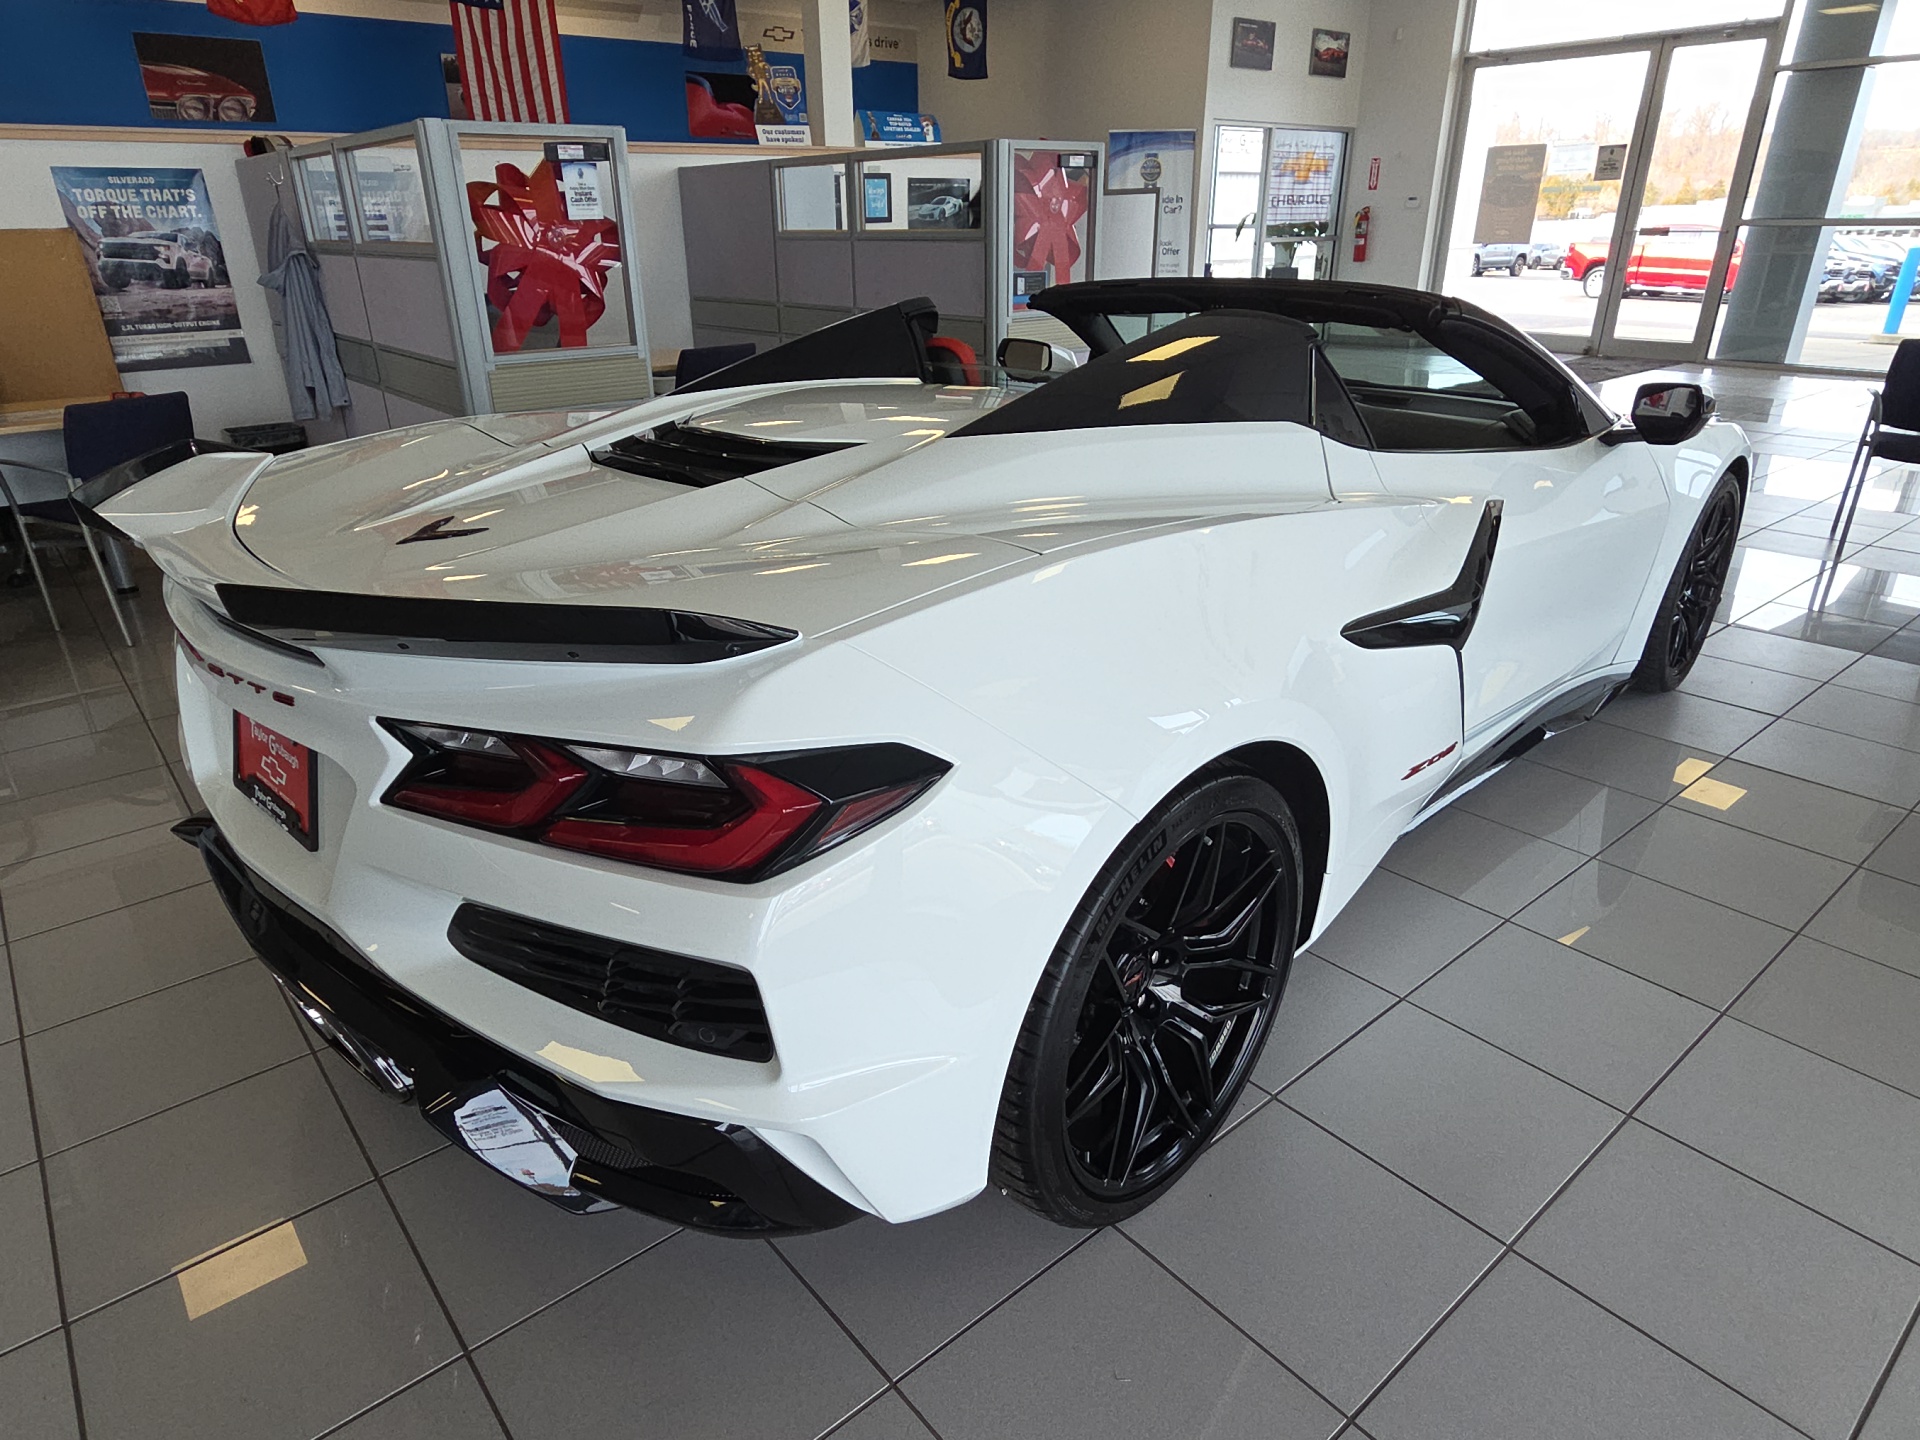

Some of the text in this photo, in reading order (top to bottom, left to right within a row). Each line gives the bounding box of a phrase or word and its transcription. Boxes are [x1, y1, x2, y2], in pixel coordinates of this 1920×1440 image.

[874, 36, 899, 49] drive
[107, 176, 155, 184] SILVERADO
[72, 188, 196, 203] TORQUE THAT'S
[1175, 194, 1183, 204] In
[77, 205, 202, 219] OFF THE CHART.
[1163, 205, 1182, 214] Car?
[1162, 247, 1180, 256] Offer
[249, 719, 268, 743] Taylor
[1400, 741, 1458, 780] Z06
[1096, 835, 1163, 936] MICHELIN
